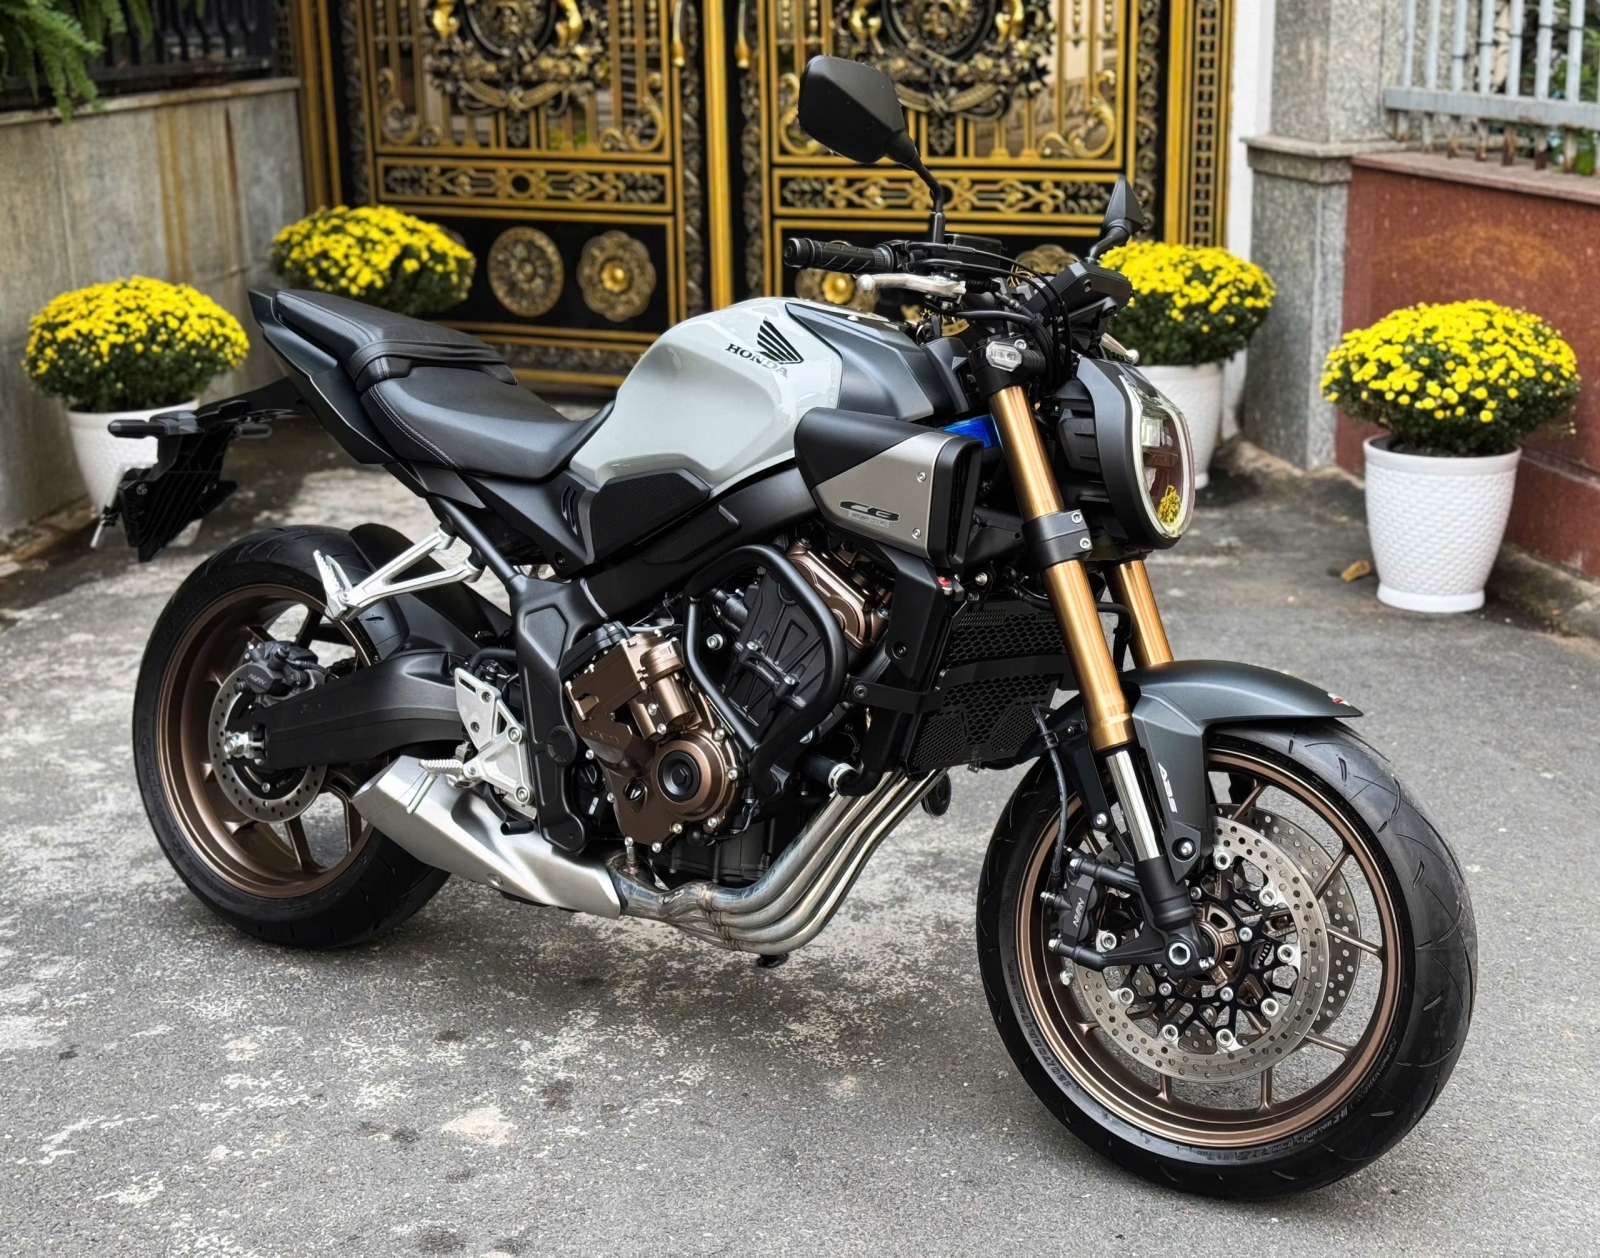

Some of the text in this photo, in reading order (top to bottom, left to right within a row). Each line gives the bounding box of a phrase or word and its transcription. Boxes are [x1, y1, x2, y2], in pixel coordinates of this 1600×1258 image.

[725, 343, 788, 378] HONDA
[840, 501, 900, 521] CB
[1157, 761, 1178, 814] ABS
